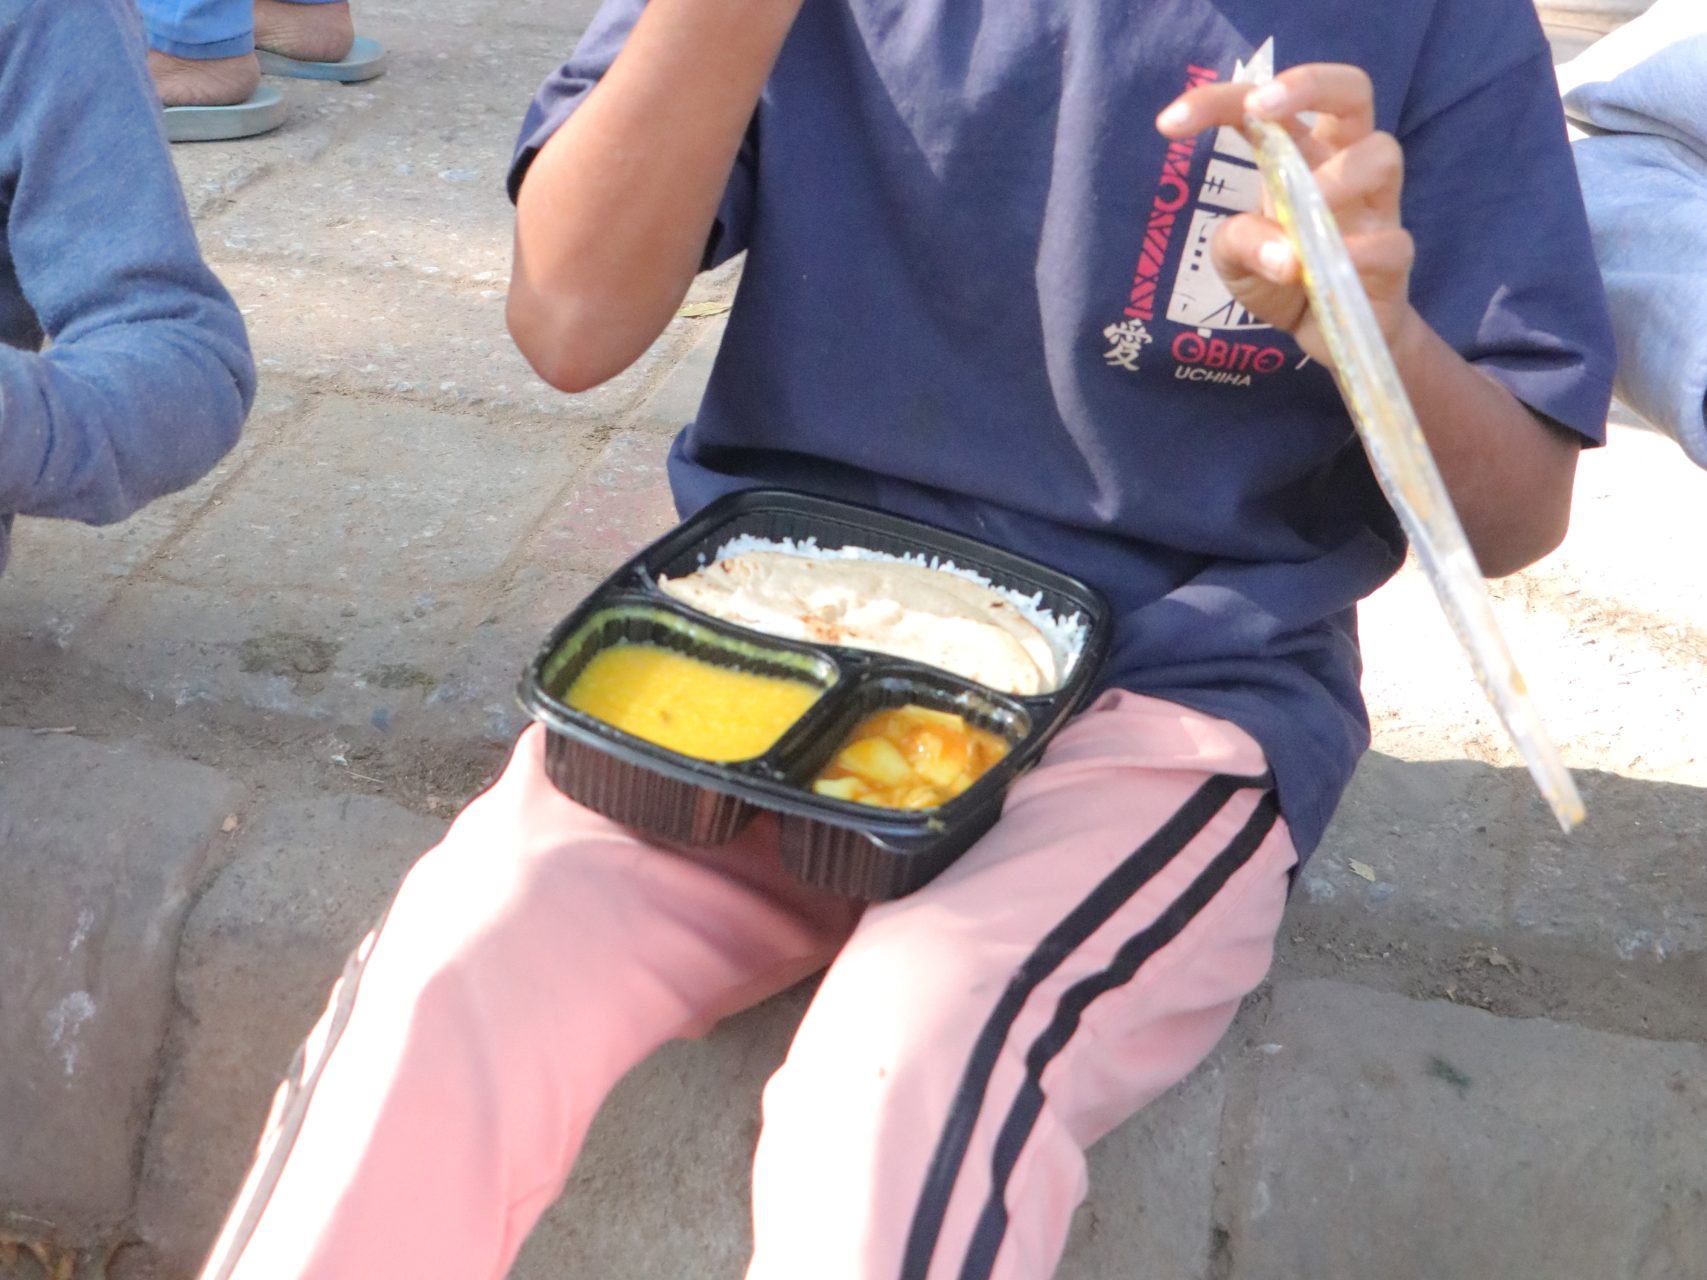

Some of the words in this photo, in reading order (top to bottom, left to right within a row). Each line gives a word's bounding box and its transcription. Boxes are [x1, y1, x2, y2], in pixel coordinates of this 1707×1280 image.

[1103, 318, 1153, 371] 愛
[1171, 331, 1285, 373] OBITO
[1174, 365, 1252, 387] UCHIHA
